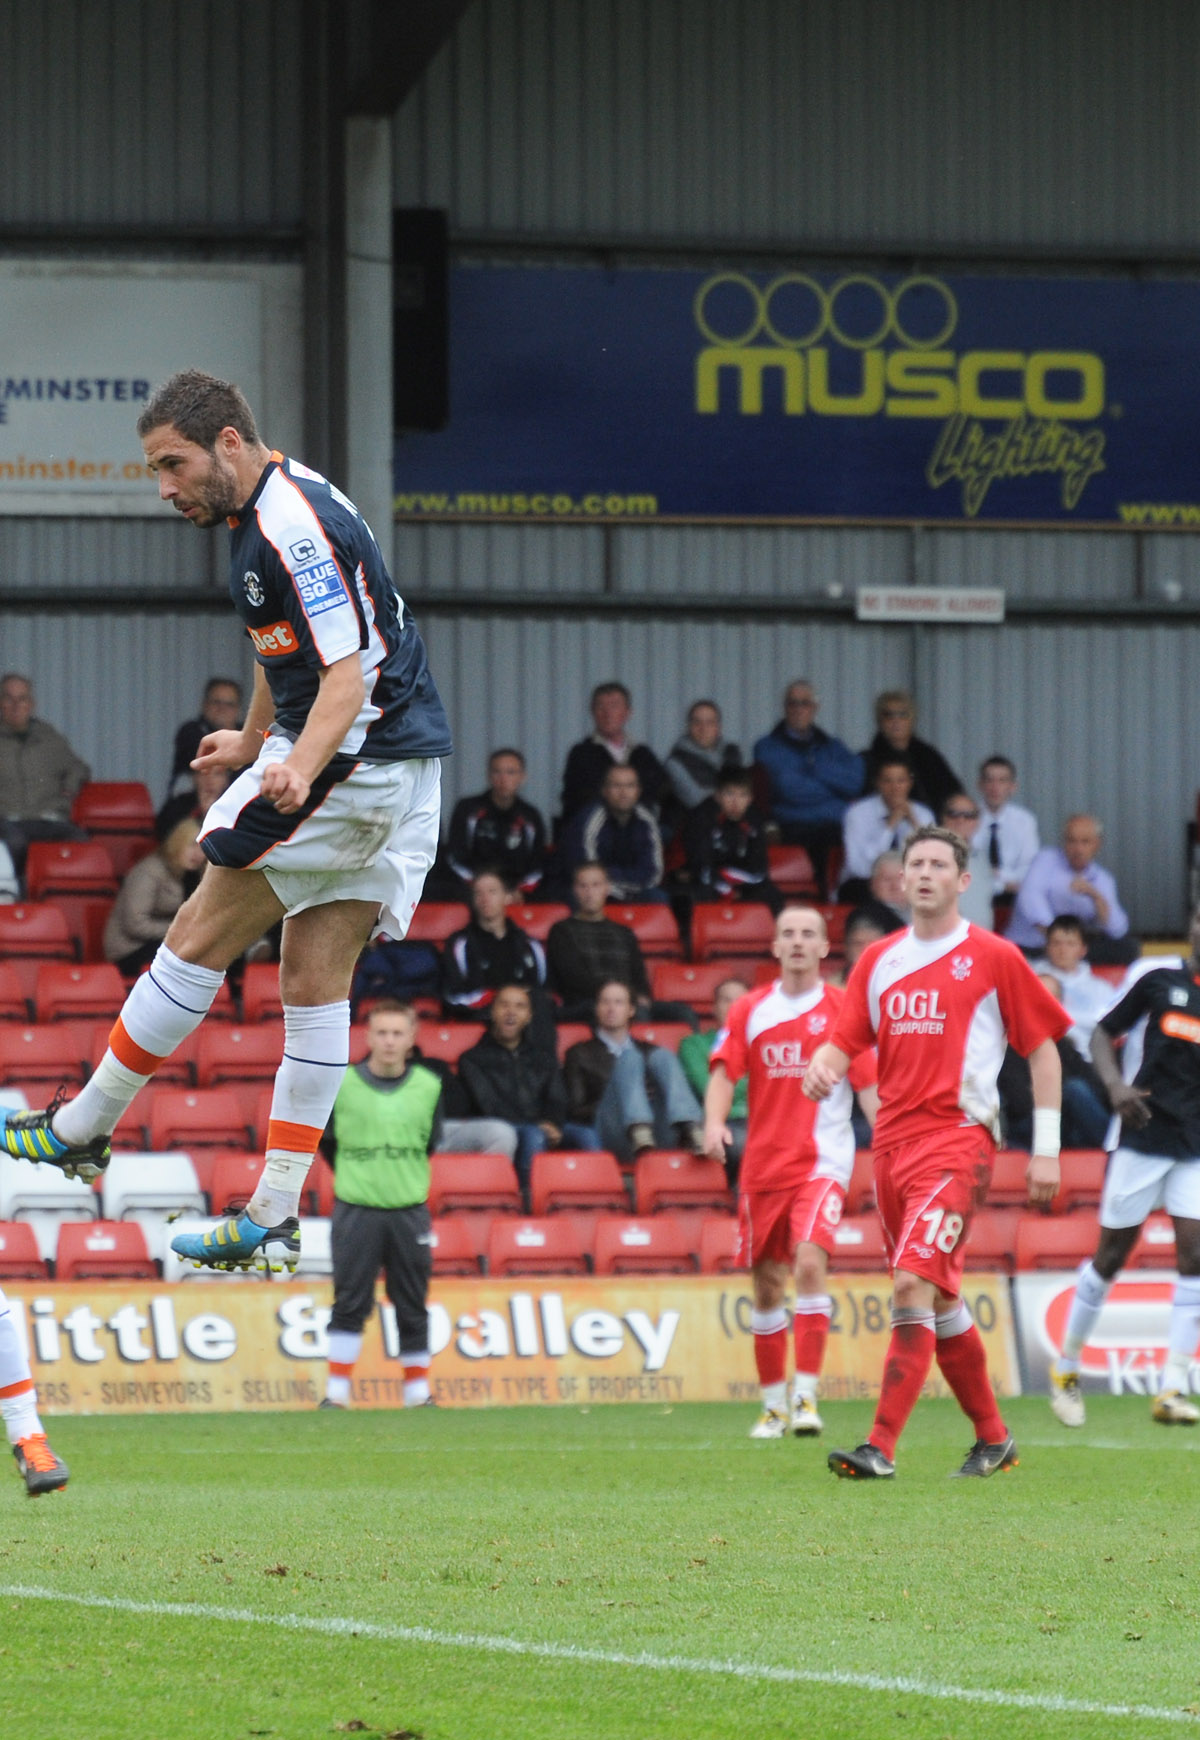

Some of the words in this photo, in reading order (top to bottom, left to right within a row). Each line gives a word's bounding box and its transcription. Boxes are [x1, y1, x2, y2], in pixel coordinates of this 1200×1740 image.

[695, 345, 1106, 420] MUSCO
[926, 410, 1106, 517] Lighting
[295, 563, 337, 589] BLUE
[301, 581, 329, 603] SQ
[307, 593, 348, 617] PREMIER
[886, 989, 947, 1021] OGL
[890, 1022, 945, 1036] COMPUTER
[761, 1042, 810, 1068] OGL
[822, 1192, 844, 1226] 8
[921, 1208, 964, 1254] 18
[278, 1294, 331, 1358] &
[101, 1380, 212, 1406] SURVEYORS
[242, 1379, 317, 1404] SELLING
[434, 1378, 492, 1402] EVERY
[501, 1377, 549, 1401] TYPE
[557, 1376, 579, 1400] OF
[588, 1375, 684, 1401] PROPERTY
